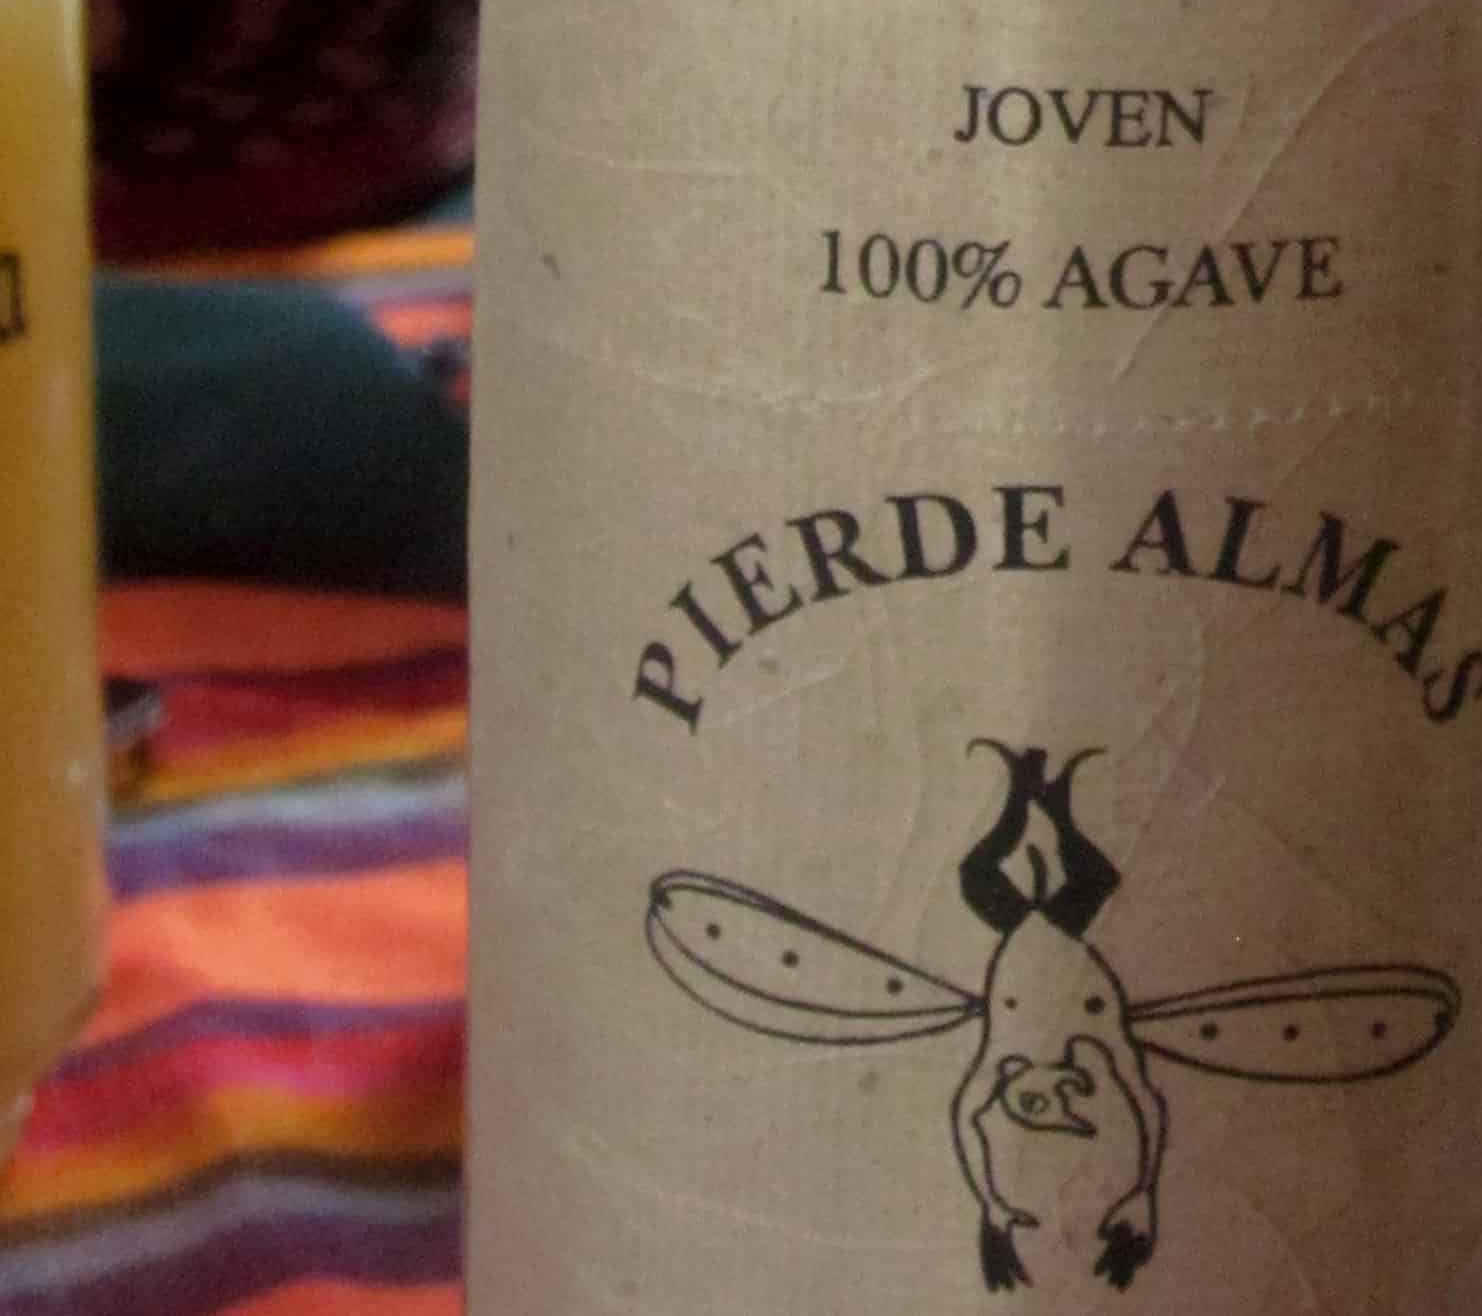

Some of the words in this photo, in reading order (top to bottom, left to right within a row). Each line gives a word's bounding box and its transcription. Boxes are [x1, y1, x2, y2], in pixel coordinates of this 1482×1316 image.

[953, 83, 1214, 148] JOVEN
[820, 228, 1023, 311] 100%
[1042, 235, 1345, 311] AGAVE
[632, 484, 1071, 737] PIERDE
